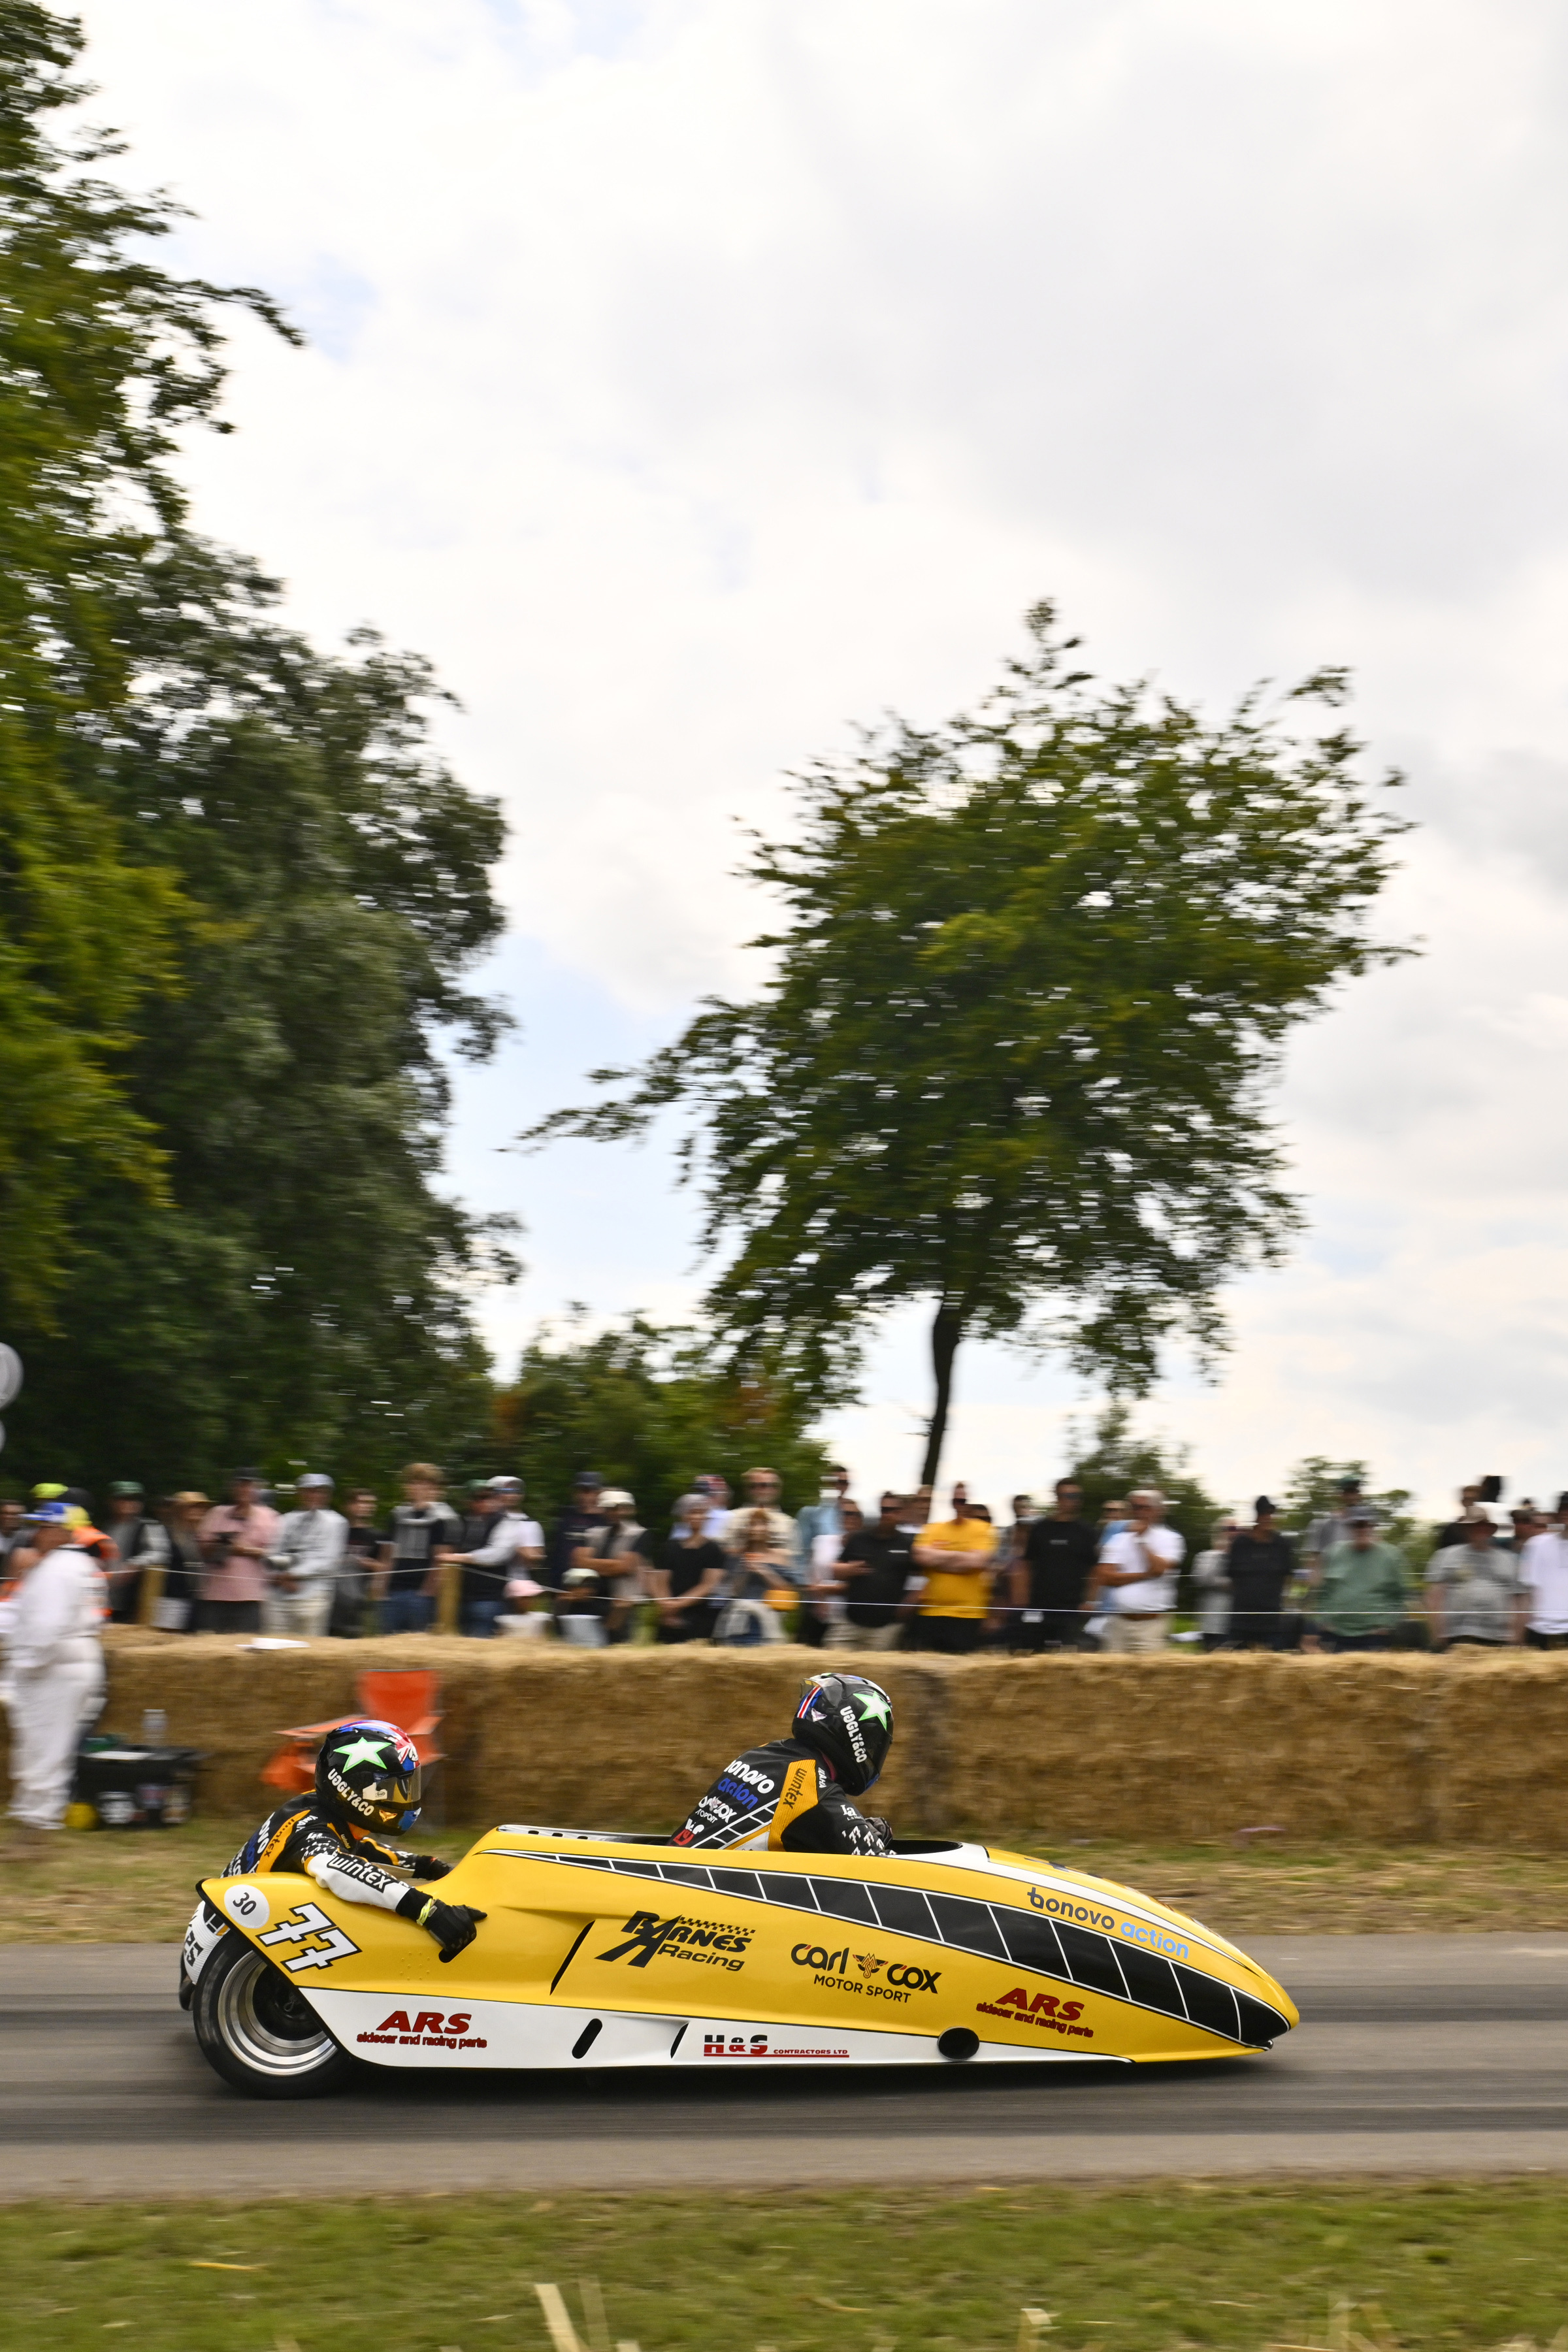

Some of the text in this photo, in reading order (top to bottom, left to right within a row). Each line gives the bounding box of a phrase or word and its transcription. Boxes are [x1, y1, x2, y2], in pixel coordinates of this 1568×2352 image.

[724, 1760, 775, 1793] onovo
[783, 1768, 807, 1809] wintex
[328, 1855, 391, 1889] wintex
[233, 1892, 257, 1916] 30
[255, 1901, 363, 1974] 77
[594, 1910, 753, 1968] BARNES
[1027, 1887, 1189, 1959] bonovo action
[657, 1943, 745, 1972] Racing
[791, 1943, 943, 1994] carl cox
[813, 1974, 911, 2003] MOTOR SPORT
[995, 1987, 1085, 2021] ARS
[376, 2010, 472, 2034] ARS
[976, 2002, 1094, 2038] sidecar and racing parts
[357, 2032, 487, 2050] sidecar and racing parts
